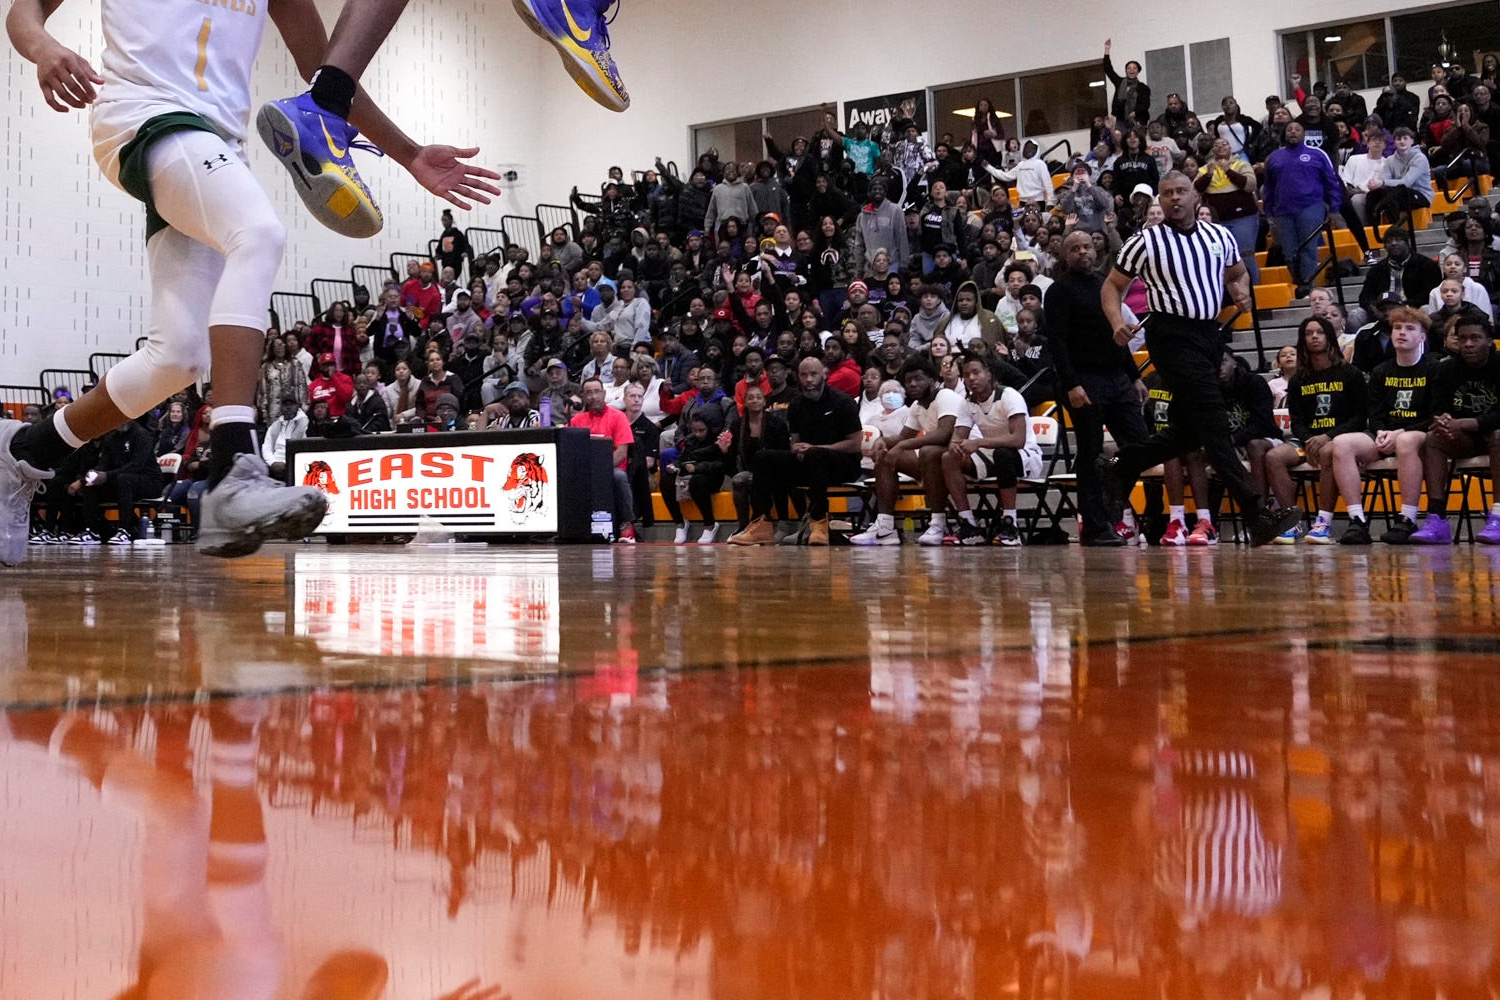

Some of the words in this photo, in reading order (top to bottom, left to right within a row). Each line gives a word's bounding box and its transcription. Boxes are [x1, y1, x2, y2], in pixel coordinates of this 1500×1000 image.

[195, 17, 211, 91] 1
[849, 107, 891, 129] Away
[1301, 381, 1343, 395] NORTHLAND
[1385, 376, 1426, 387] NORTHLAND
[1453, 398, 1463, 407] 22
[347, 452, 494, 487] EAST
[350, 488, 396, 510] HIGH
[407, 487, 490, 509] SCHOOL
